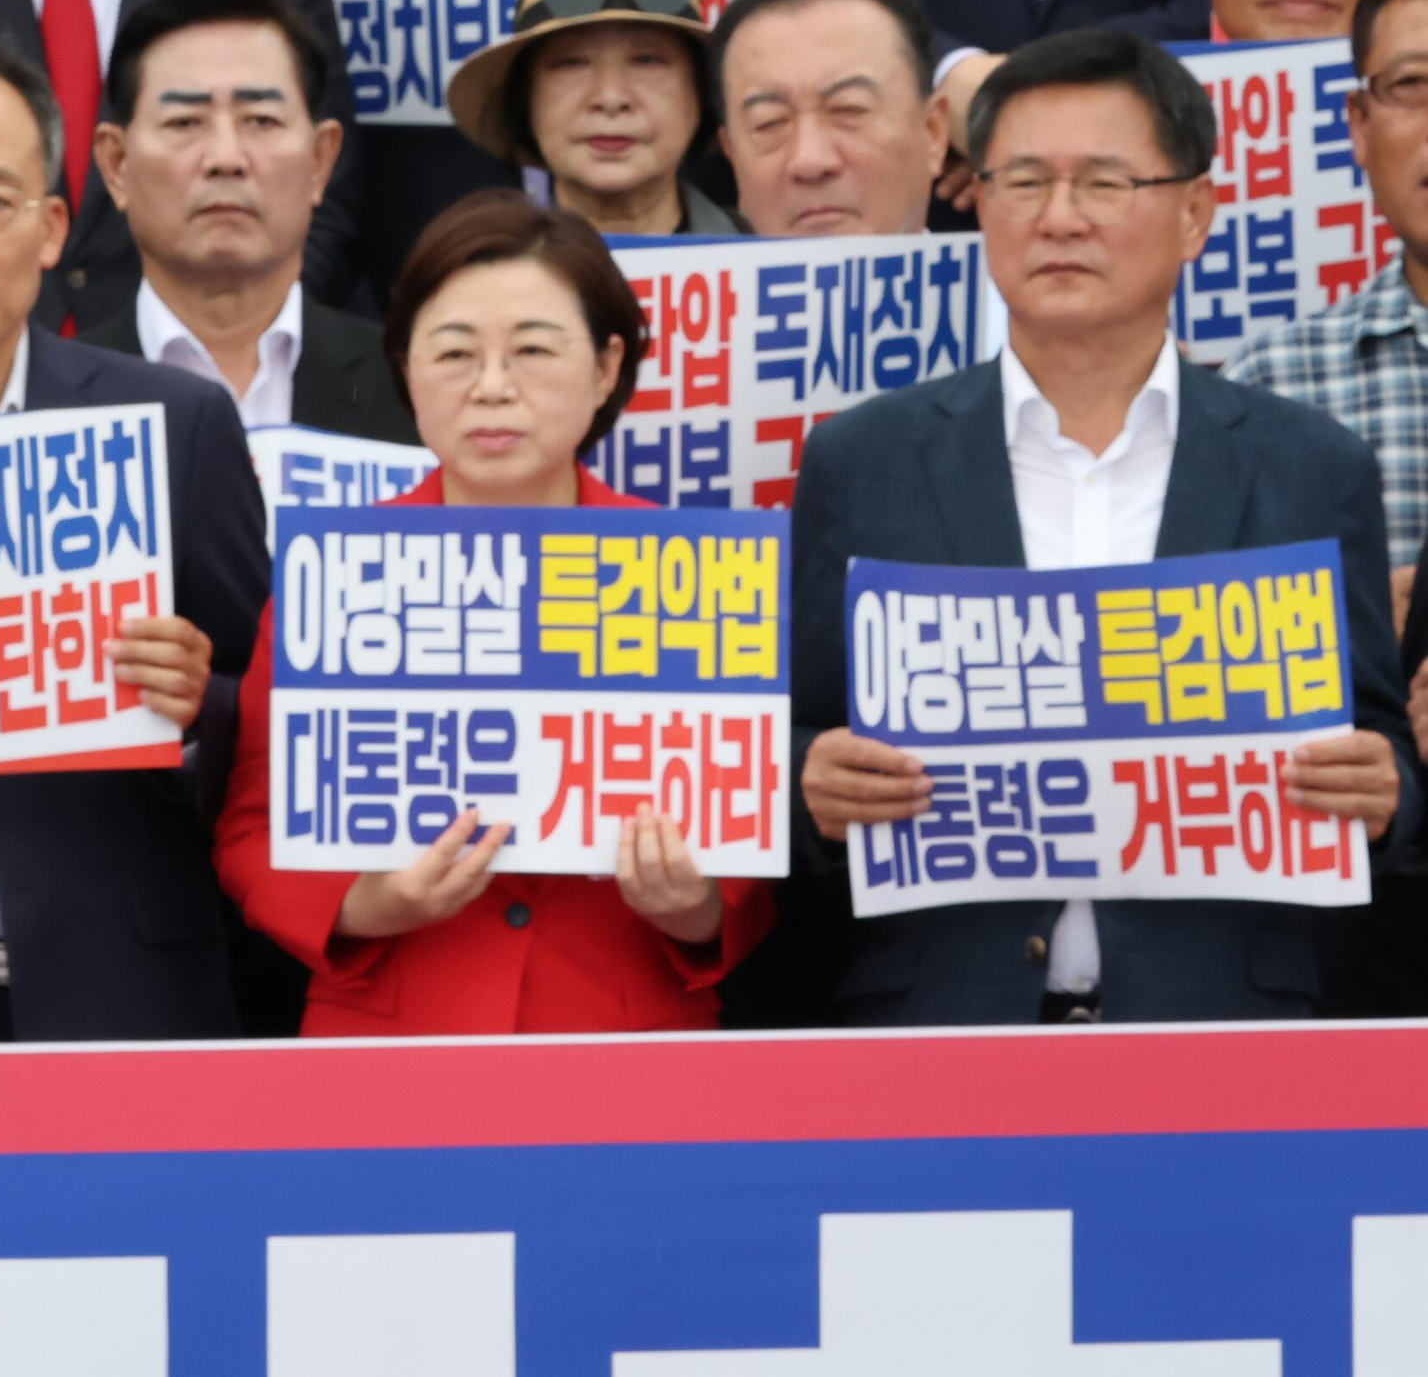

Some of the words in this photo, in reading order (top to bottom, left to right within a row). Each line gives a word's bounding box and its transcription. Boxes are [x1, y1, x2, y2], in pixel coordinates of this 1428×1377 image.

[754, 240, 981, 403] 독재정치
[1174, 209, 1297, 344] 보복
[283, 532, 528, 677] 야당말살
[537, 534, 779, 680] 특검악법
[851, 589, 1088, 734] 야당말살
[1095, 568, 1344, 726] 특검악법
[284, 708, 519, 847] 대통령은
[538, 709, 780, 852] 거부하라
